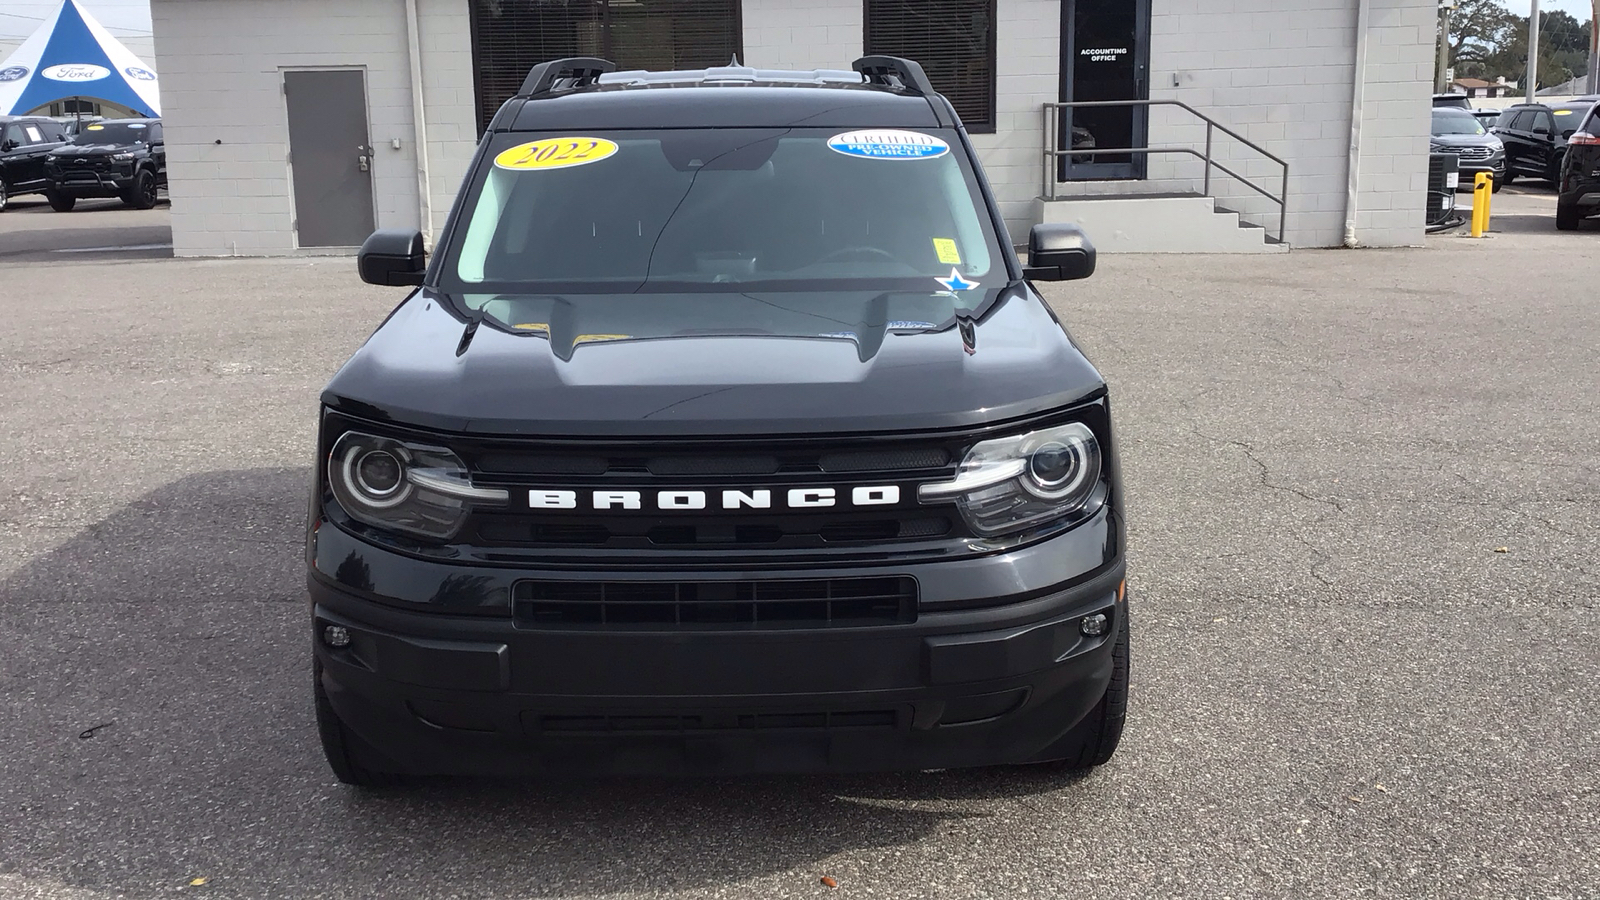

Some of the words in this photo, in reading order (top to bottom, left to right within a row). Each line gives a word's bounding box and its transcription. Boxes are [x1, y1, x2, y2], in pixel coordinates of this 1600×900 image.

[56, 67, 95, 79] Ford
[513, 141, 598, 165] 2022
[847, 143, 933, 152] PRE-OWNED
[528, 485, 900, 510] BRONCO
